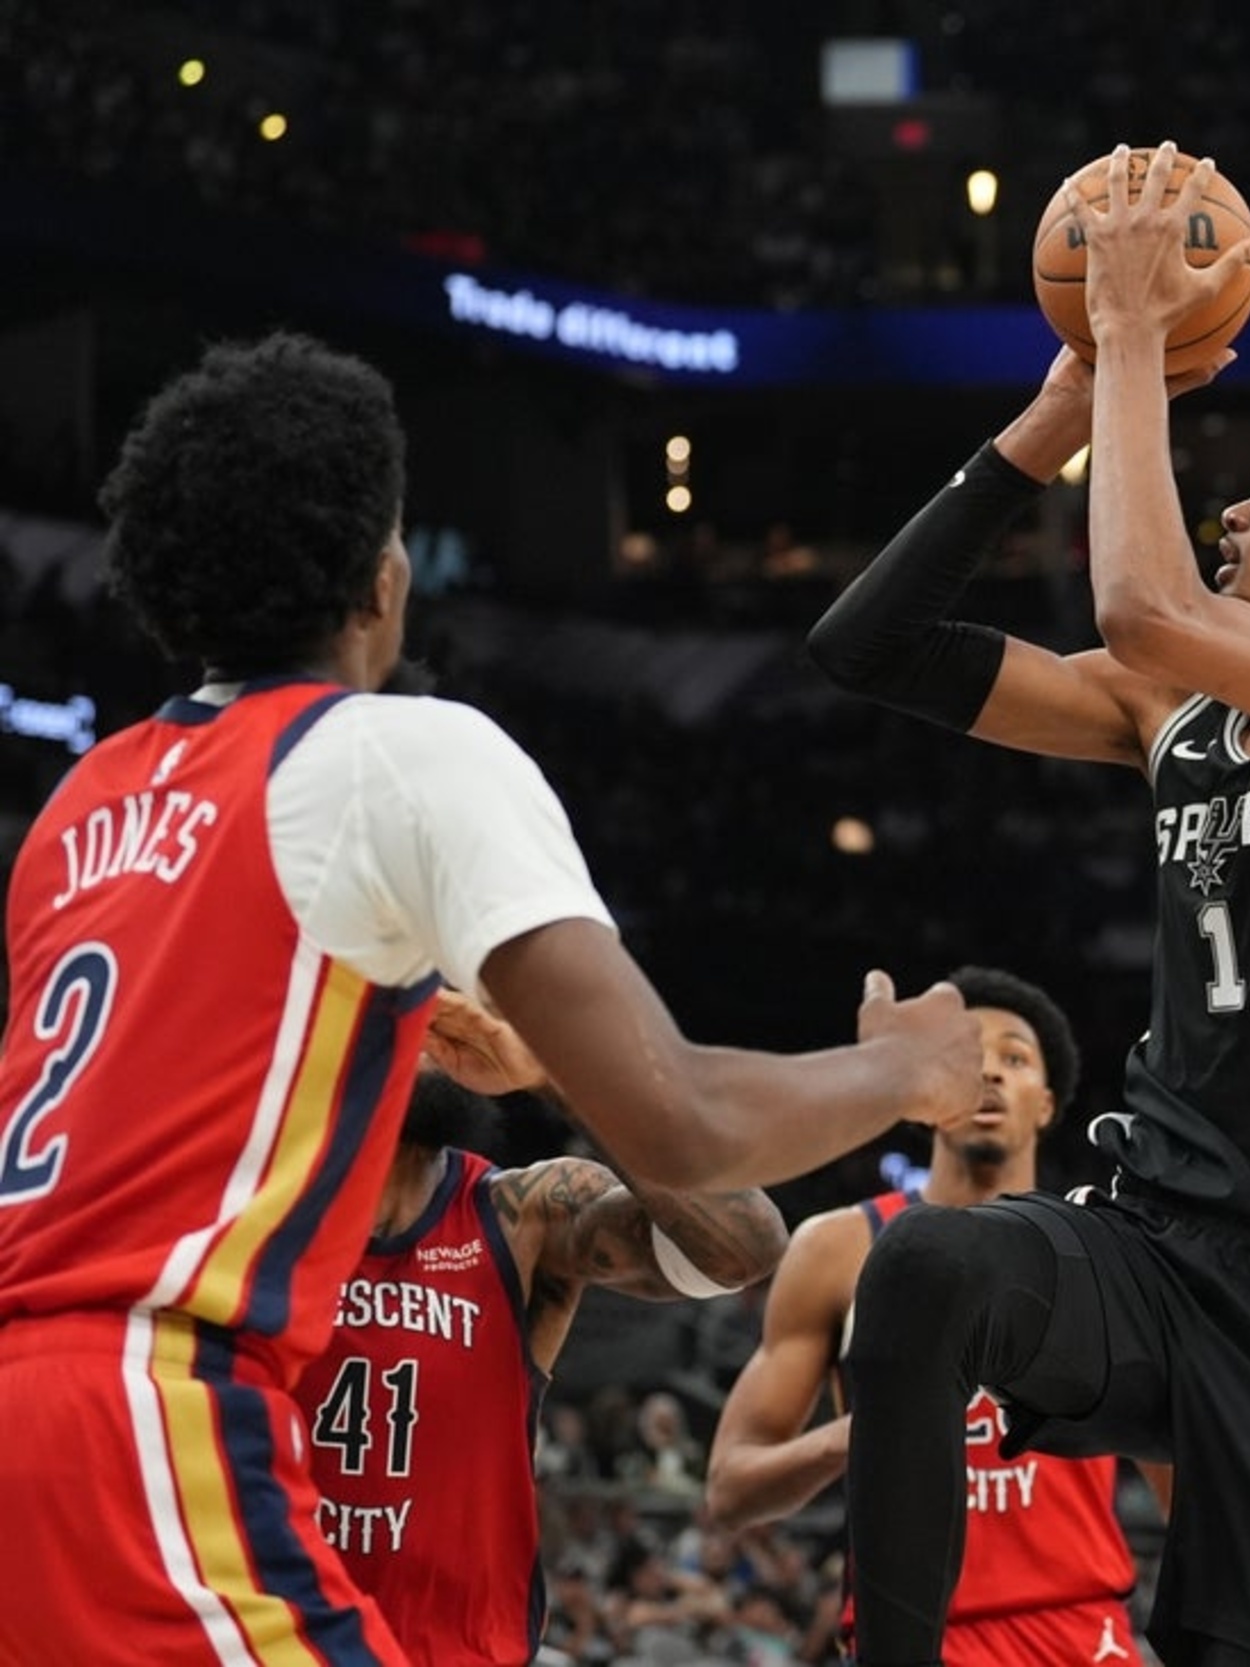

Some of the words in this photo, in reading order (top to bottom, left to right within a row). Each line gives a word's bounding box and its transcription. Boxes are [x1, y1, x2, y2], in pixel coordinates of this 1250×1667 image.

[444, 274, 554, 340] Trade
[556, 302, 738, 373] different
[53, 791, 218, 910] JONES
[1197, 901, 1247, 1012] 1
[0, 941, 118, 1207] 2
[312, 1357, 419, 1477] 41
[314, 1497, 412, 1554] CITY
